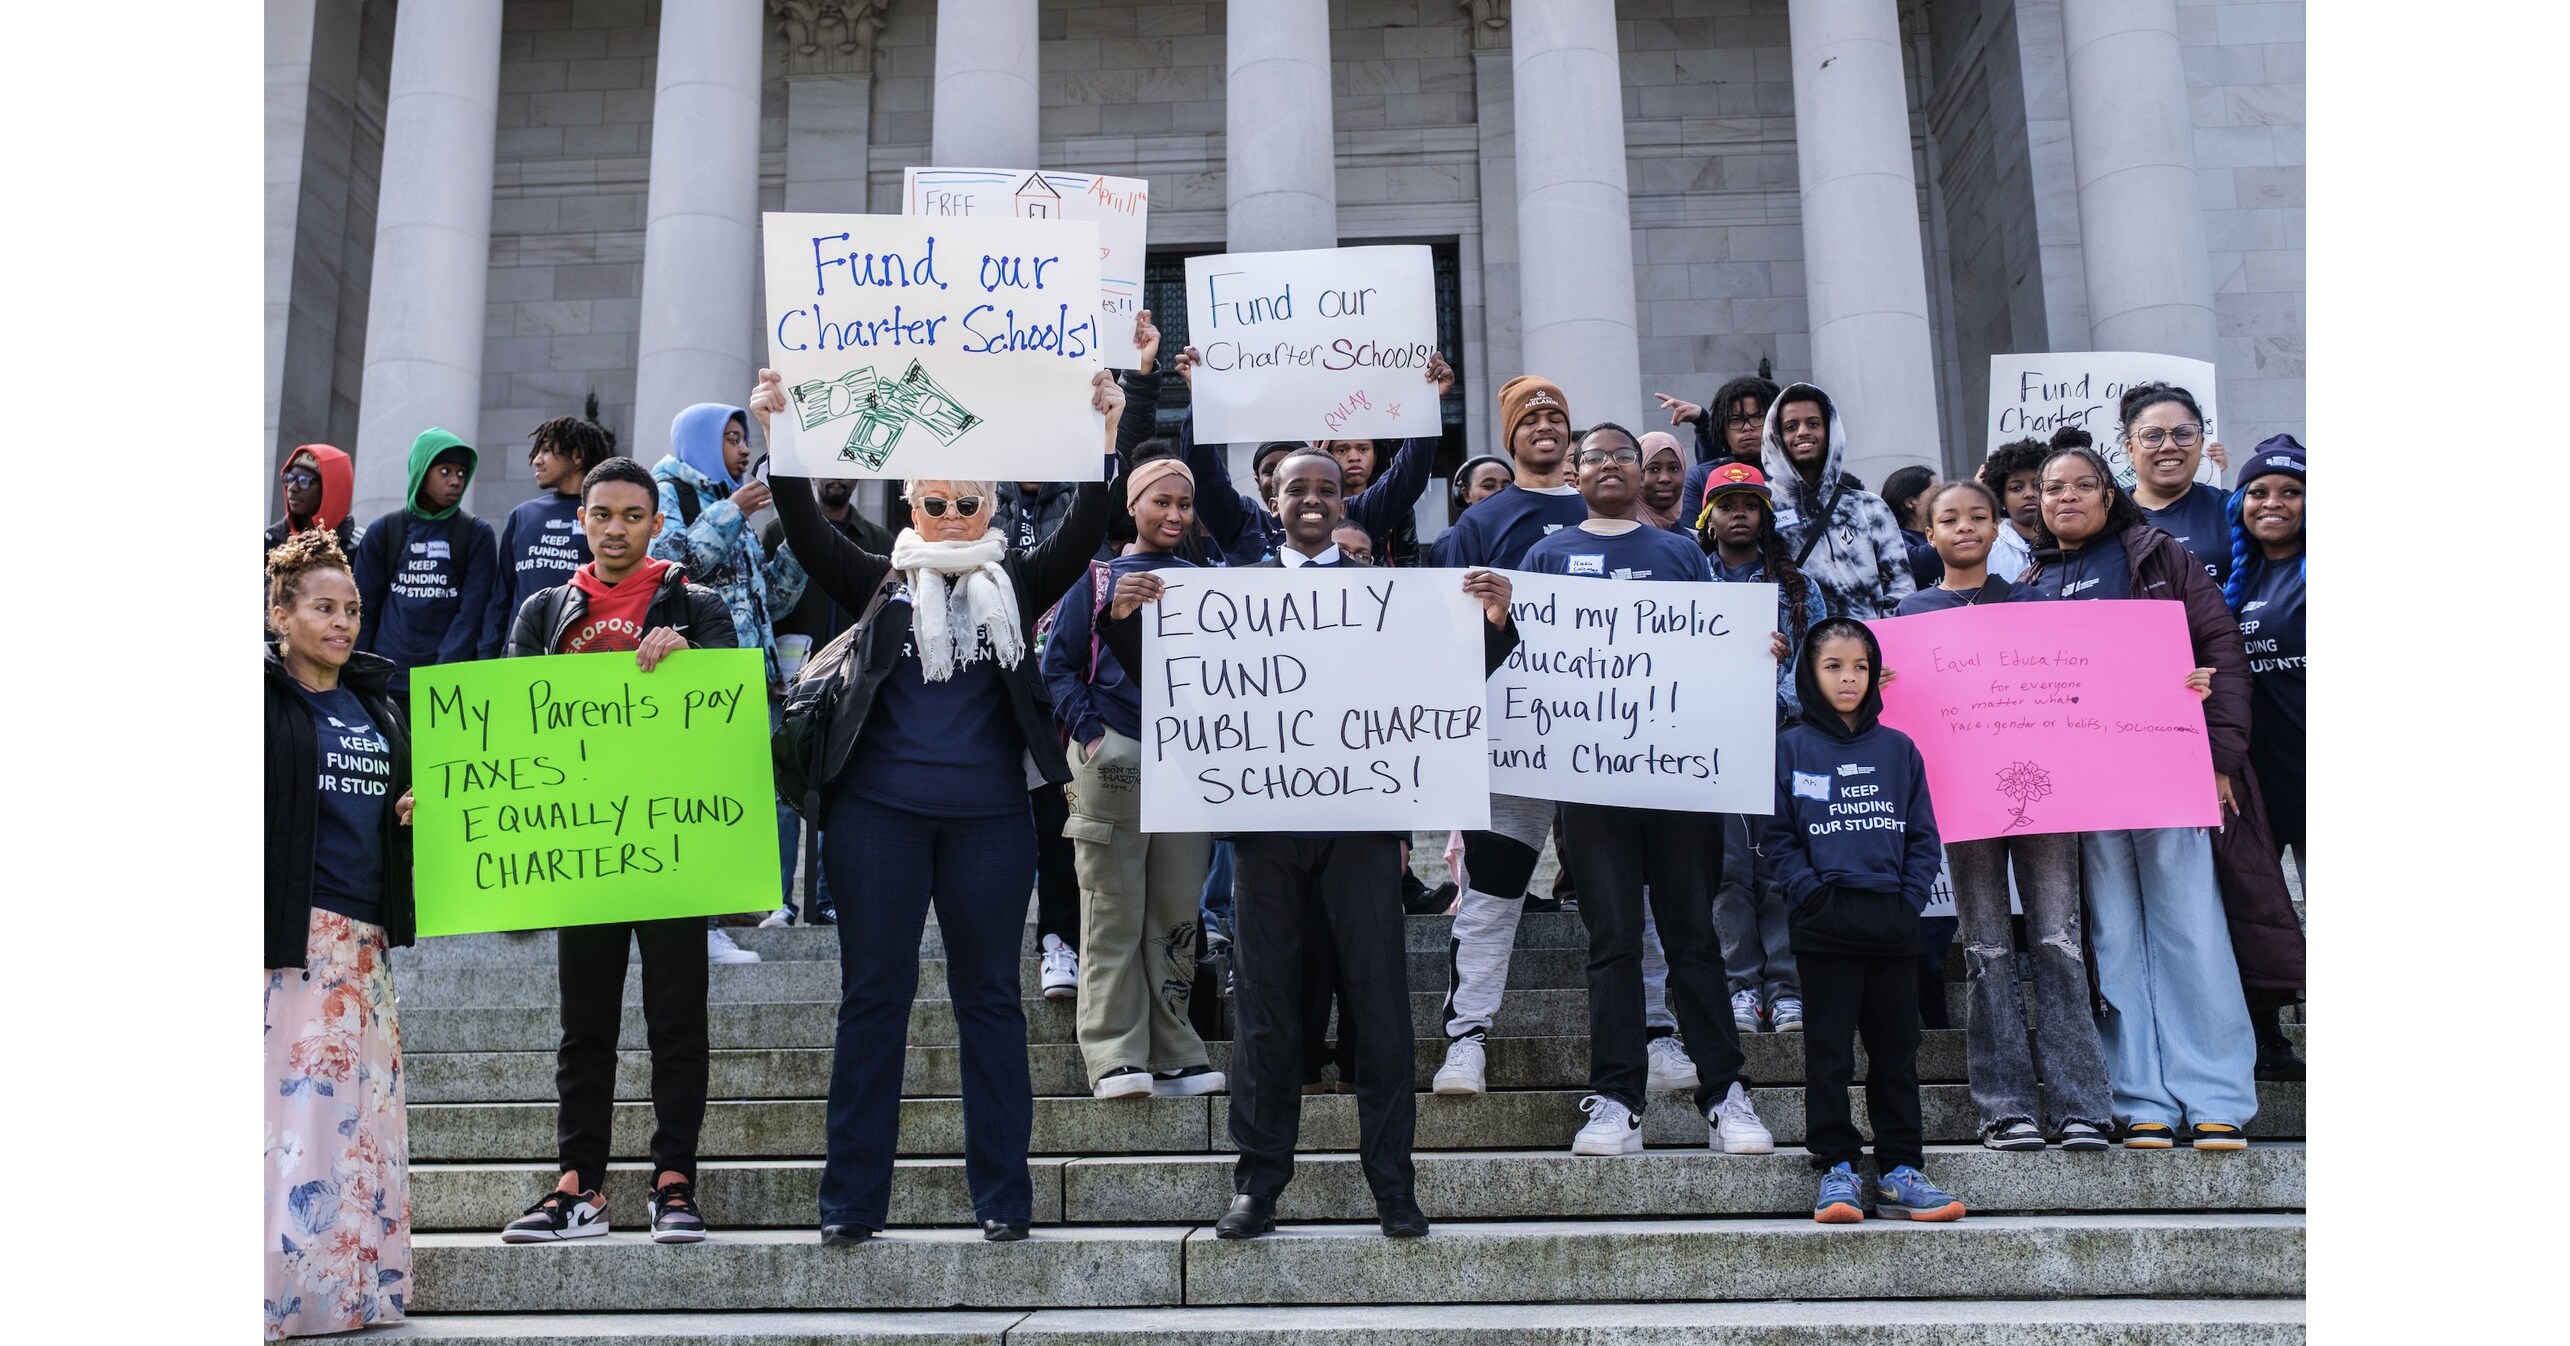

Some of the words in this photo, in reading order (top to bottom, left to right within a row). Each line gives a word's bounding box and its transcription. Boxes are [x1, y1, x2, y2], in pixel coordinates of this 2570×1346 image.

[1088, 176, 1123, 213] April
[812, 232, 948, 296] Fund
[980, 255, 1059, 293] our
[1209, 271, 1292, 329] Fund
[1318, 287, 1377, 319] our
[777, 303, 948, 351] Charter
[962, 303, 1098, 363] Schools!
[1205, 340, 1323, 371] Charter
[2020, 371, 2090, 403] Fund
[1999, 404, 2104, 434] Charter
[528, 545, 579, 560] FUNDING
[541, 534, 570, 546] KEEP
[398, 572, 448, 585] FUNDING
[408, 560, 438, 571] KEEP
[515, 559, 534, 572] OUR
[535, 558, 582, 571] STUDEN
[390, 582, 407, 595] UR
[1156, 580, 1394, 641] EQUALLY
[1510, 592, 1556, 627] und
[1575, 606, 1619, 646] my
[1632, 599, 1731, 637] Public
[2239, 620, 2261, 635] EEP
[1508, 639, 1652, 680] ducation
[1932, 647, 1982, 673] Equal
[1999, 648, 2089, 668] Education
[2244, 638, 2278, 655] DING
[1165, 654, 1308, 708] FUND
[1991, 680, 2010, 694] for
[2019, 681, 2082, 697] everyone
[429, 684, 491, 752] My
[528, 679, 659, 735] Parents
[683, 682, 745, 730] pay
[1505, 681, 1678, 740] Equally!!
[1940, 706, 1959, 718] no
[1970, 697, 2025, 711] matter
[1154, 709, 1316, 762] PUBLIC
[1339, 704, 1483, 750] CHARTER
[2043, 719, 2056, 728] or
[339, 735, 381, 753] KEEP
[326, 752, 390, 776] FUNDIN
[428, 739, 588, 800] TAXES!
[1572, 742, 1719, 785] Charters!
[341, 776, 388, 796] STUD
[1197, 755, 1421, 805] SCHOOLS!
[1840, 784, 1879, 798] KEEP
[464, 794, 630, 843] EQUALLY
[646, 794, 745, 830] FUND
[1828, 800, 1895, 816] FUNDING
[1808, 820, 1842, 835] OUR
[1844, 816, 1907, 834] STUDENT
[475, 833, 681, 891] CHARTERS!
